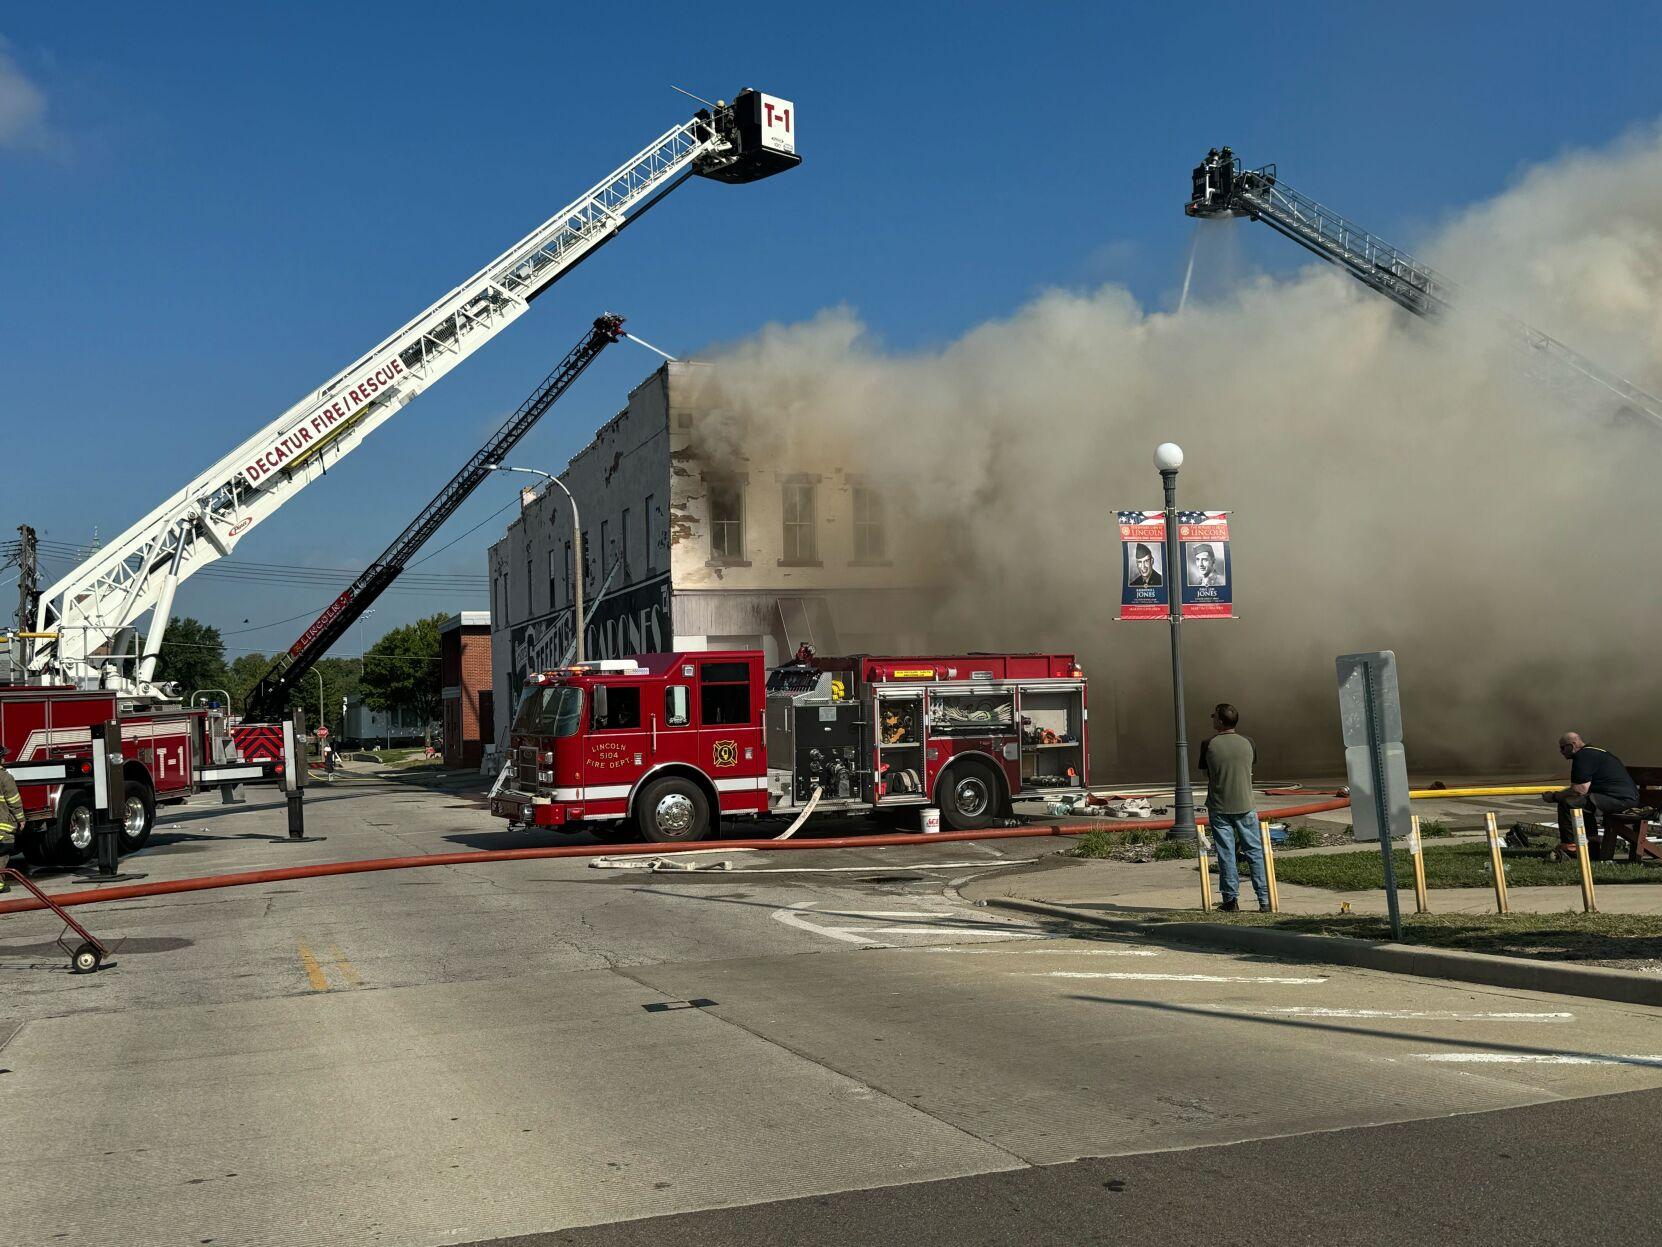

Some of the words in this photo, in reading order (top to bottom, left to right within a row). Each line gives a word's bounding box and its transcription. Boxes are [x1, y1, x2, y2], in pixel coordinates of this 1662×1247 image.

[764, 102, 790, 133] T-1
[245, 427, 314, 481] DECATUR
[300, 602, 341, 645] LINCOLN
[156, 746, 185, 779] T-1
[586, 758, 606, 769] FIRE
[591, 743, 627, 753] LINCOLN
[599, 752, 619, 760] 5104
